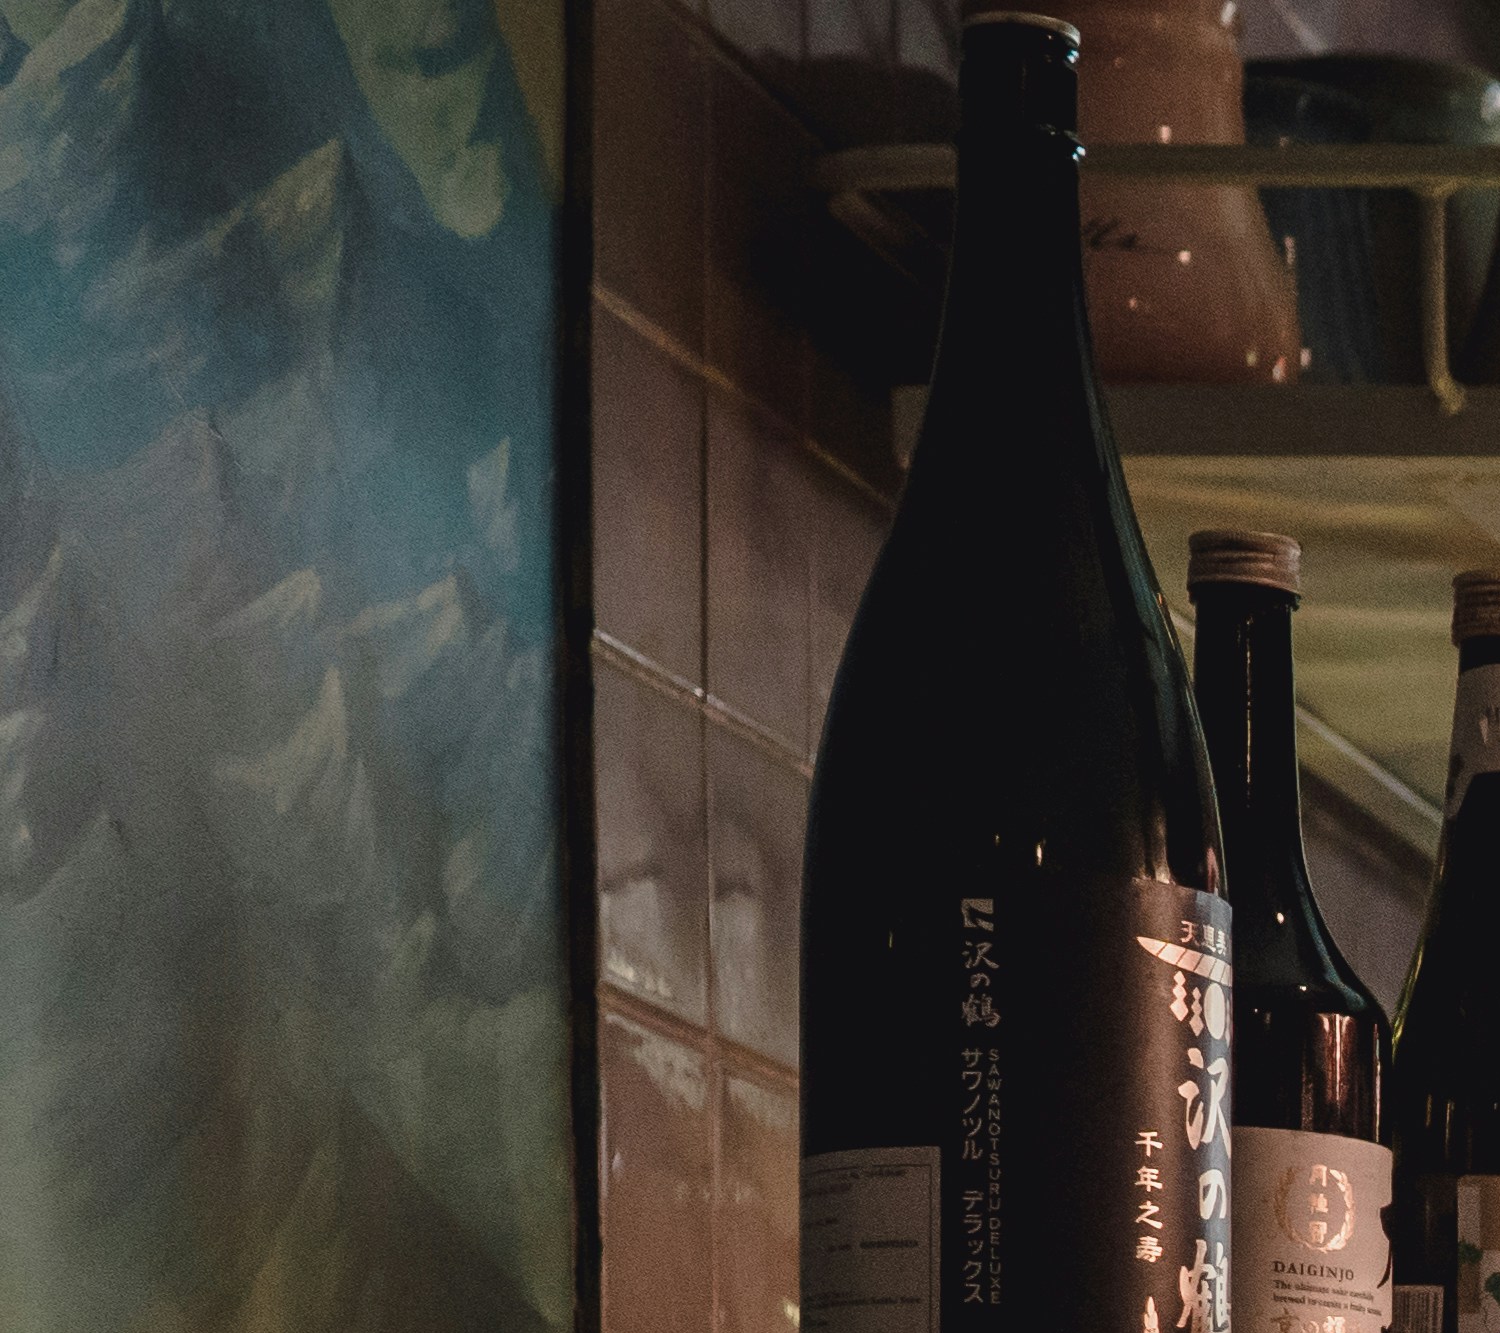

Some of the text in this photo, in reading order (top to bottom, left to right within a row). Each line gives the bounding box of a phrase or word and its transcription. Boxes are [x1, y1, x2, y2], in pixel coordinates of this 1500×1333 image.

[961, 940, 1001, 1028] 沢の鶴
[961, 1047, 985, 1304] サワノツル デラックス
[986, 1048, 1002, 1305] SAWANOTSURU DELUXE
[1272, 1260, 1355, 1283] DAIGINJO
